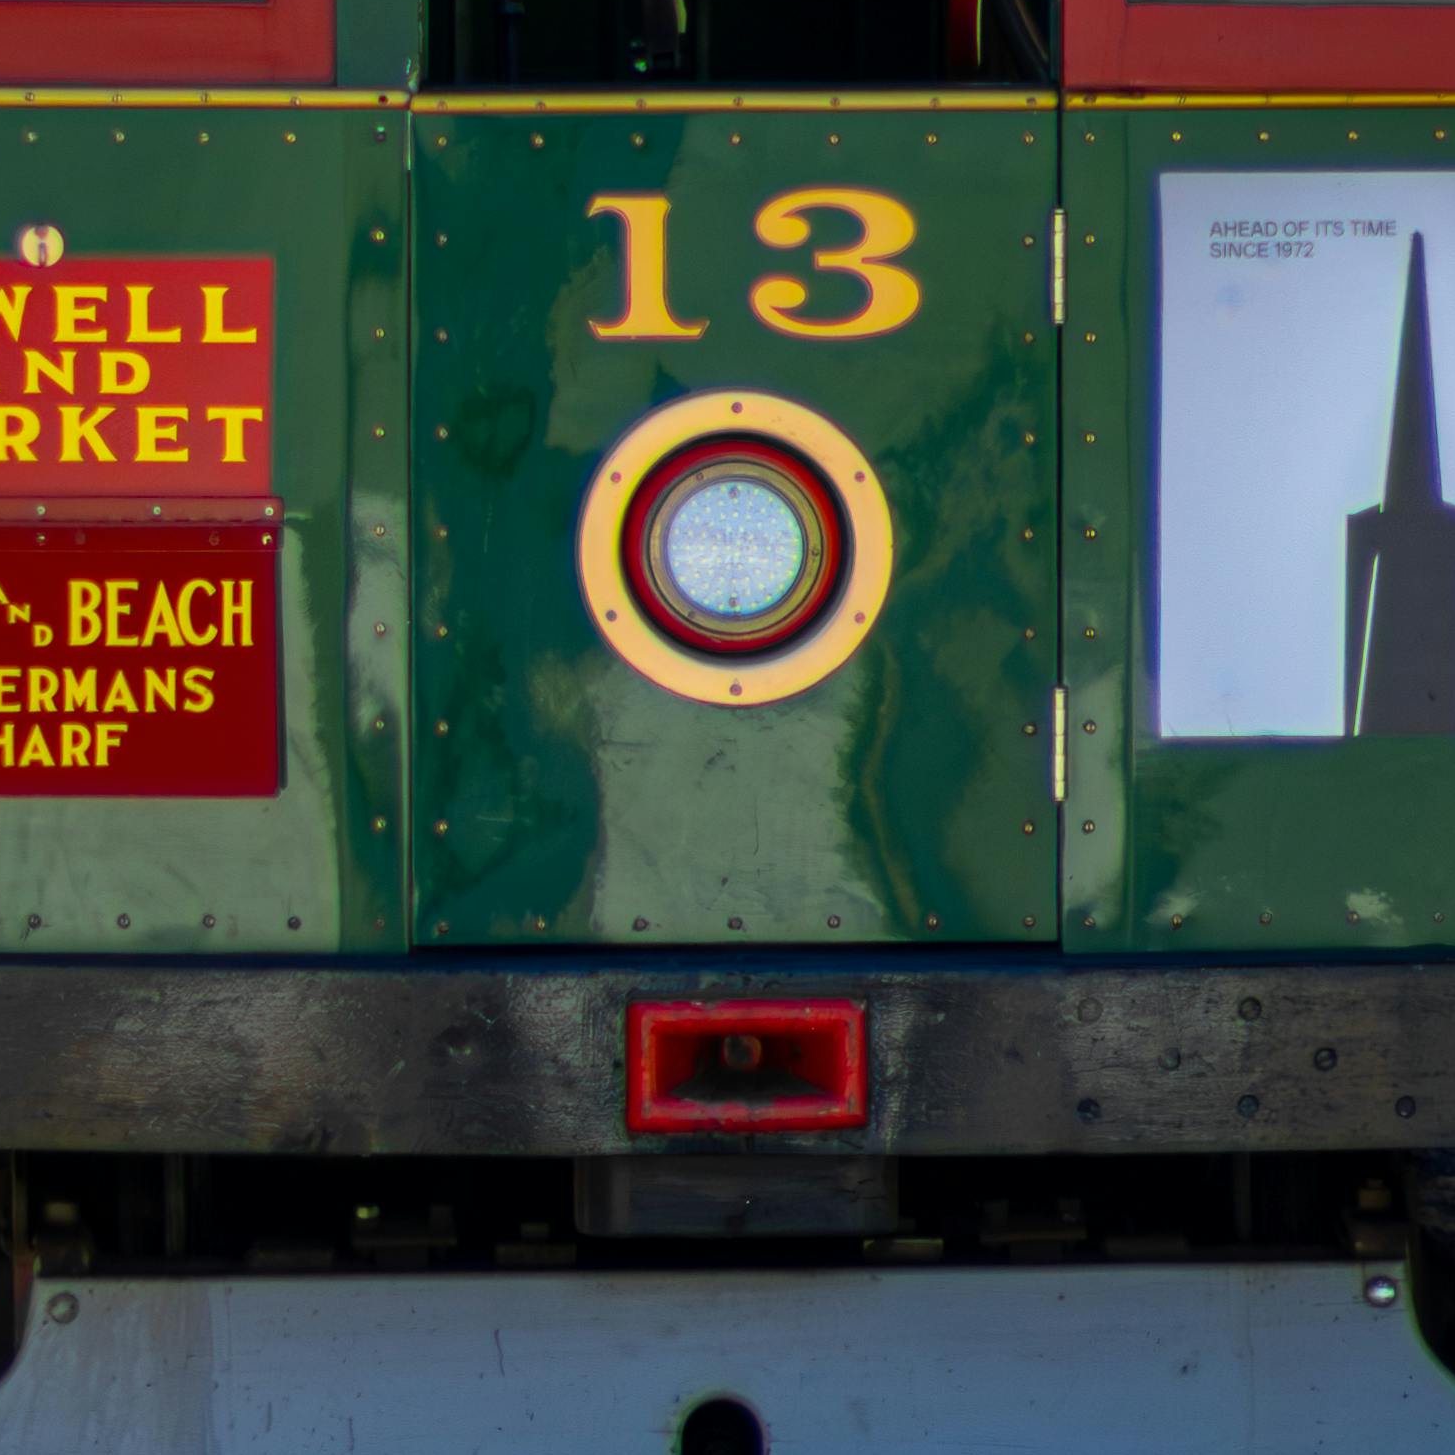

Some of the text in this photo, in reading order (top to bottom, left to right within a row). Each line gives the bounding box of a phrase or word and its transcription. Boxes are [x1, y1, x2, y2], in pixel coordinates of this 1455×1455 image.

[1209, 220, 1278, 238] AHEAD
[1283, 220, 1310, 238] OF
[1350, 219, 1397, 237] TIME
[1209, 241, 1315, 258] SINCE 1972
[587, 190, 922, 340] 13
[68, 579, 253, 646] BEACH
